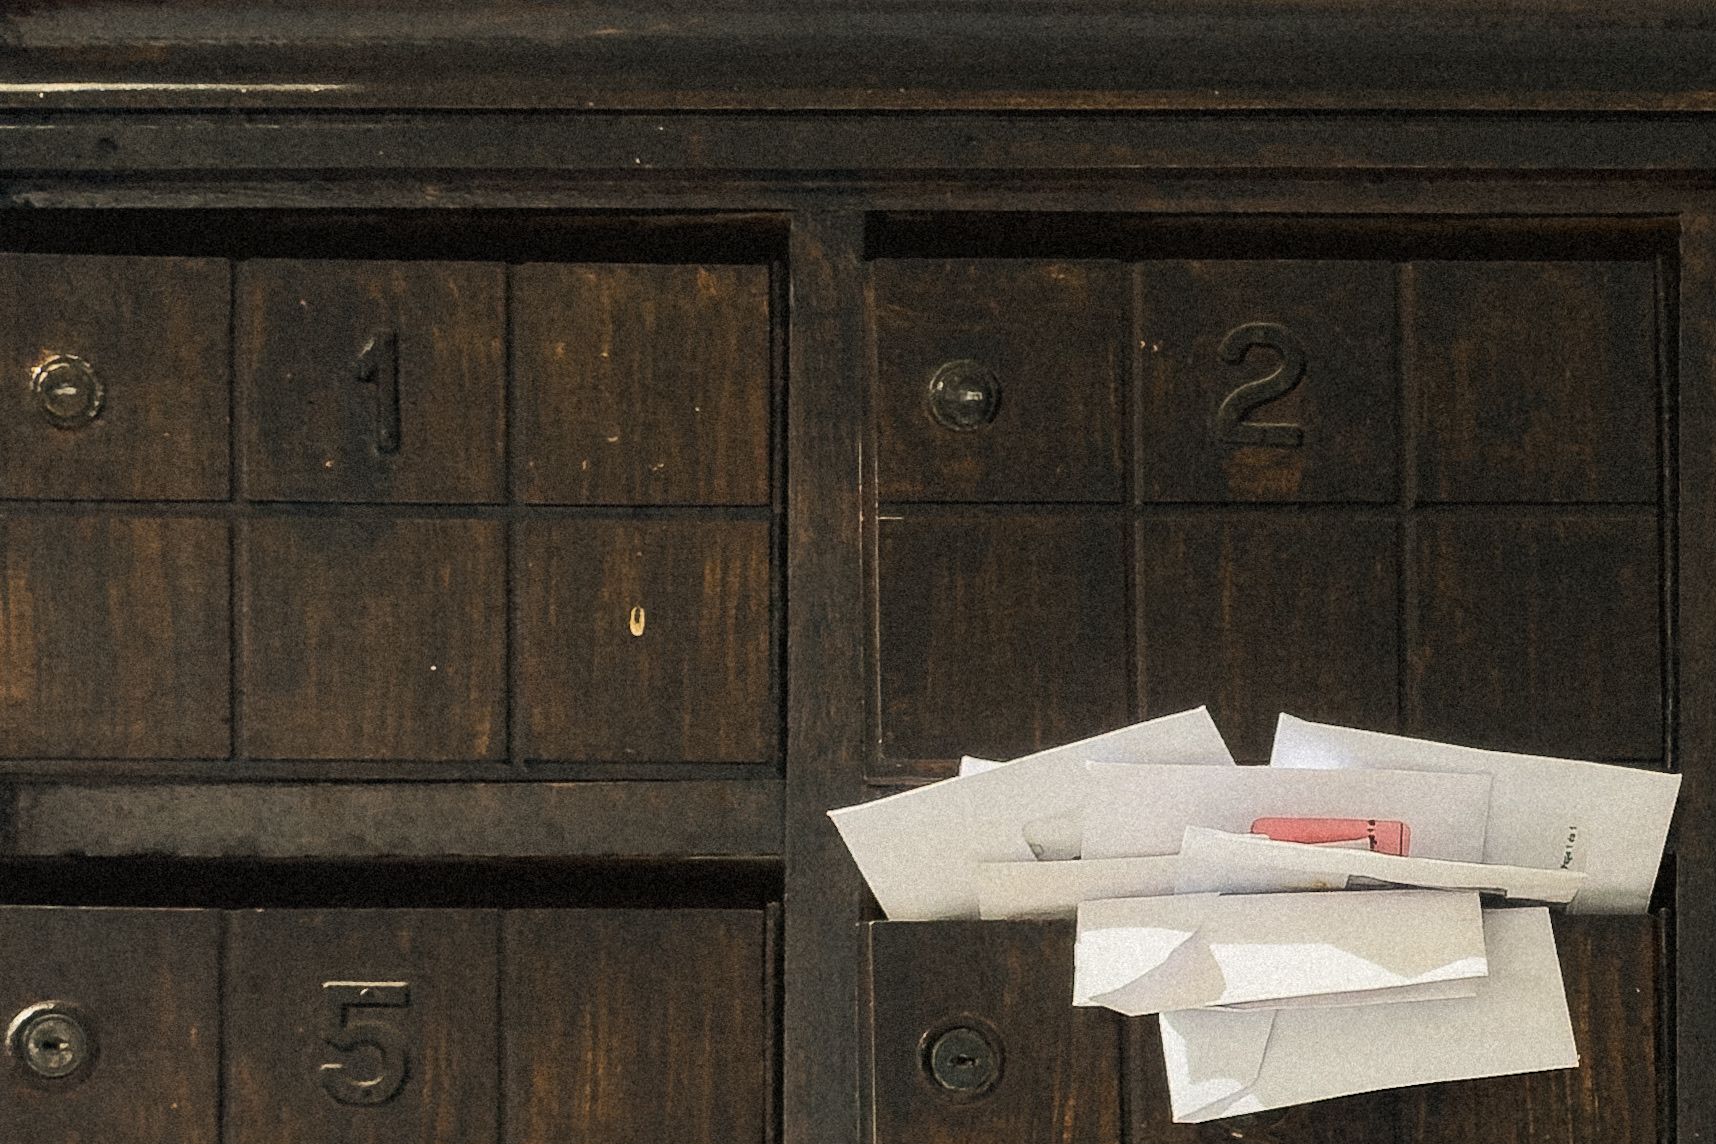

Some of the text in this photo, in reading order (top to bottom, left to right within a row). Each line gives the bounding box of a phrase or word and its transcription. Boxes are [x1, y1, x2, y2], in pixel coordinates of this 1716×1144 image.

[356, 329, 402, 454] 1
[1216, 322, 1308, 449] 2
[320, 980, 411, 1106] 5
